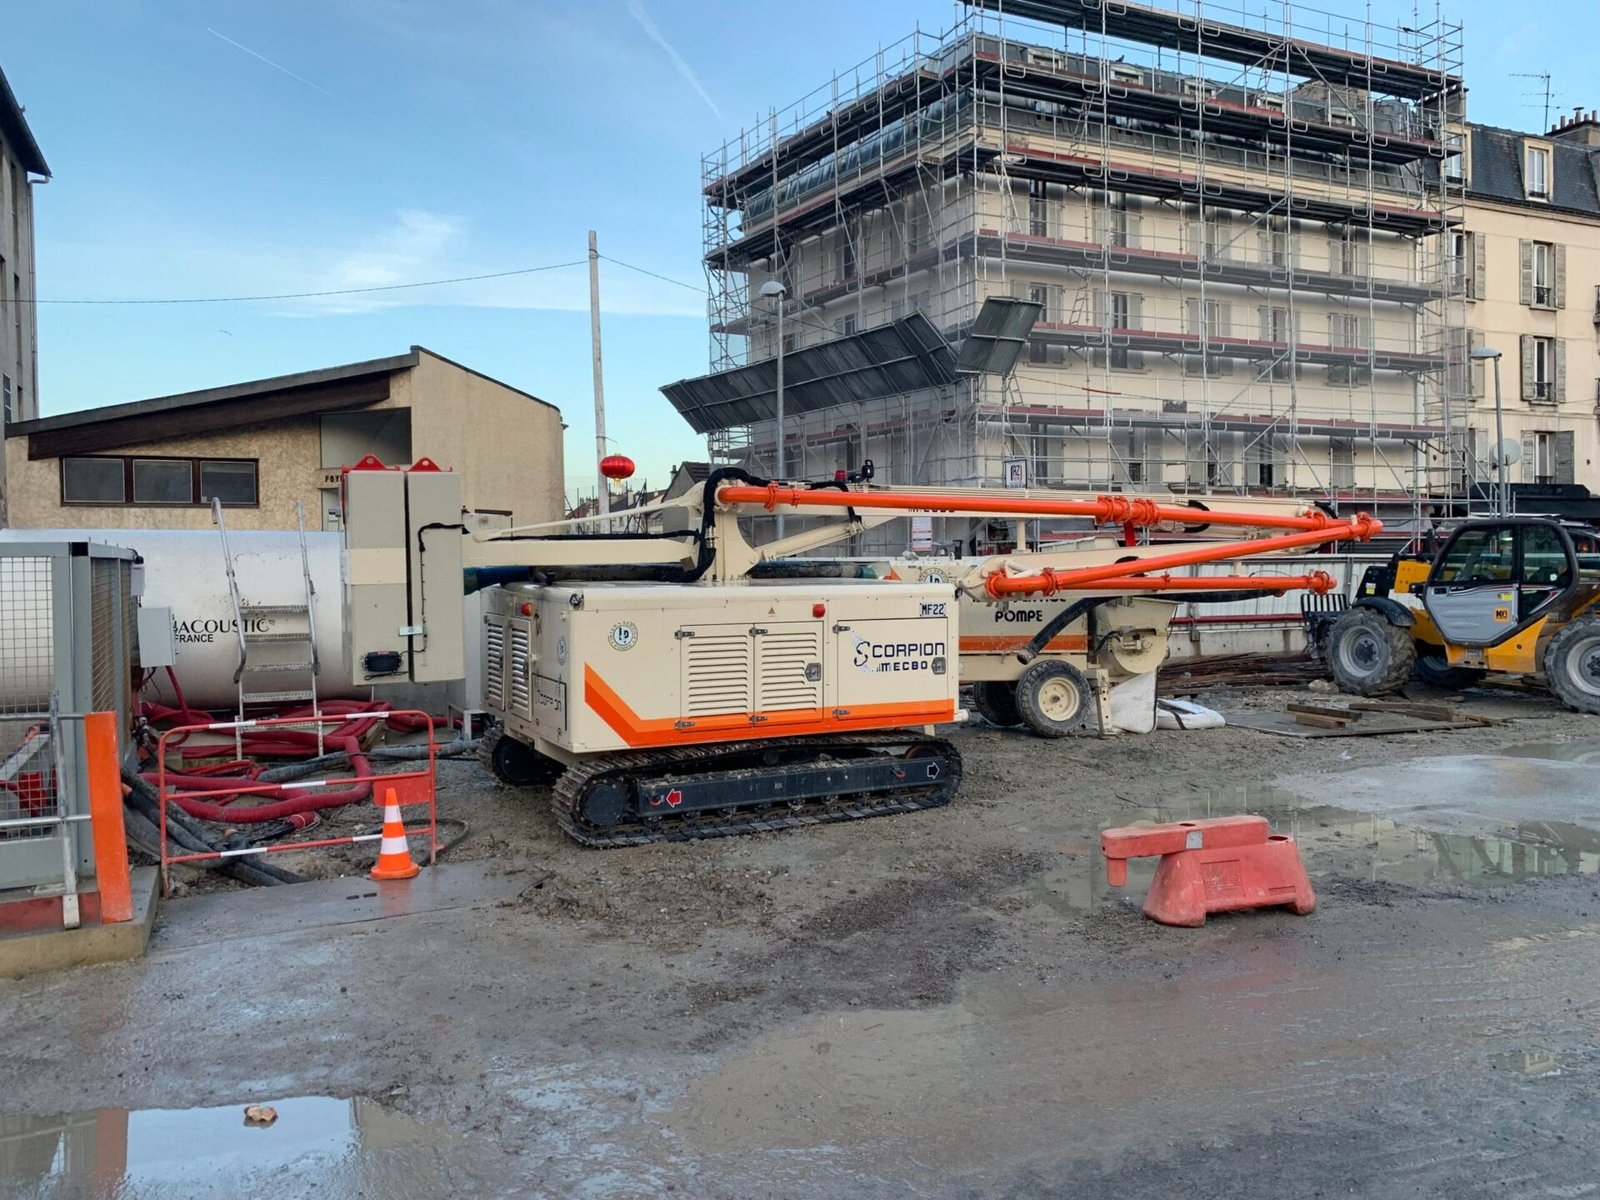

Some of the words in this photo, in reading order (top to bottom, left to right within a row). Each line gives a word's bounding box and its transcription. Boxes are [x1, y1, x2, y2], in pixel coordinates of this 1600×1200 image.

[921, 604, 945, 615] MF22
[995, 610, 1042, 622] POMPE
[853, 641, 945, 667] SCORPION
